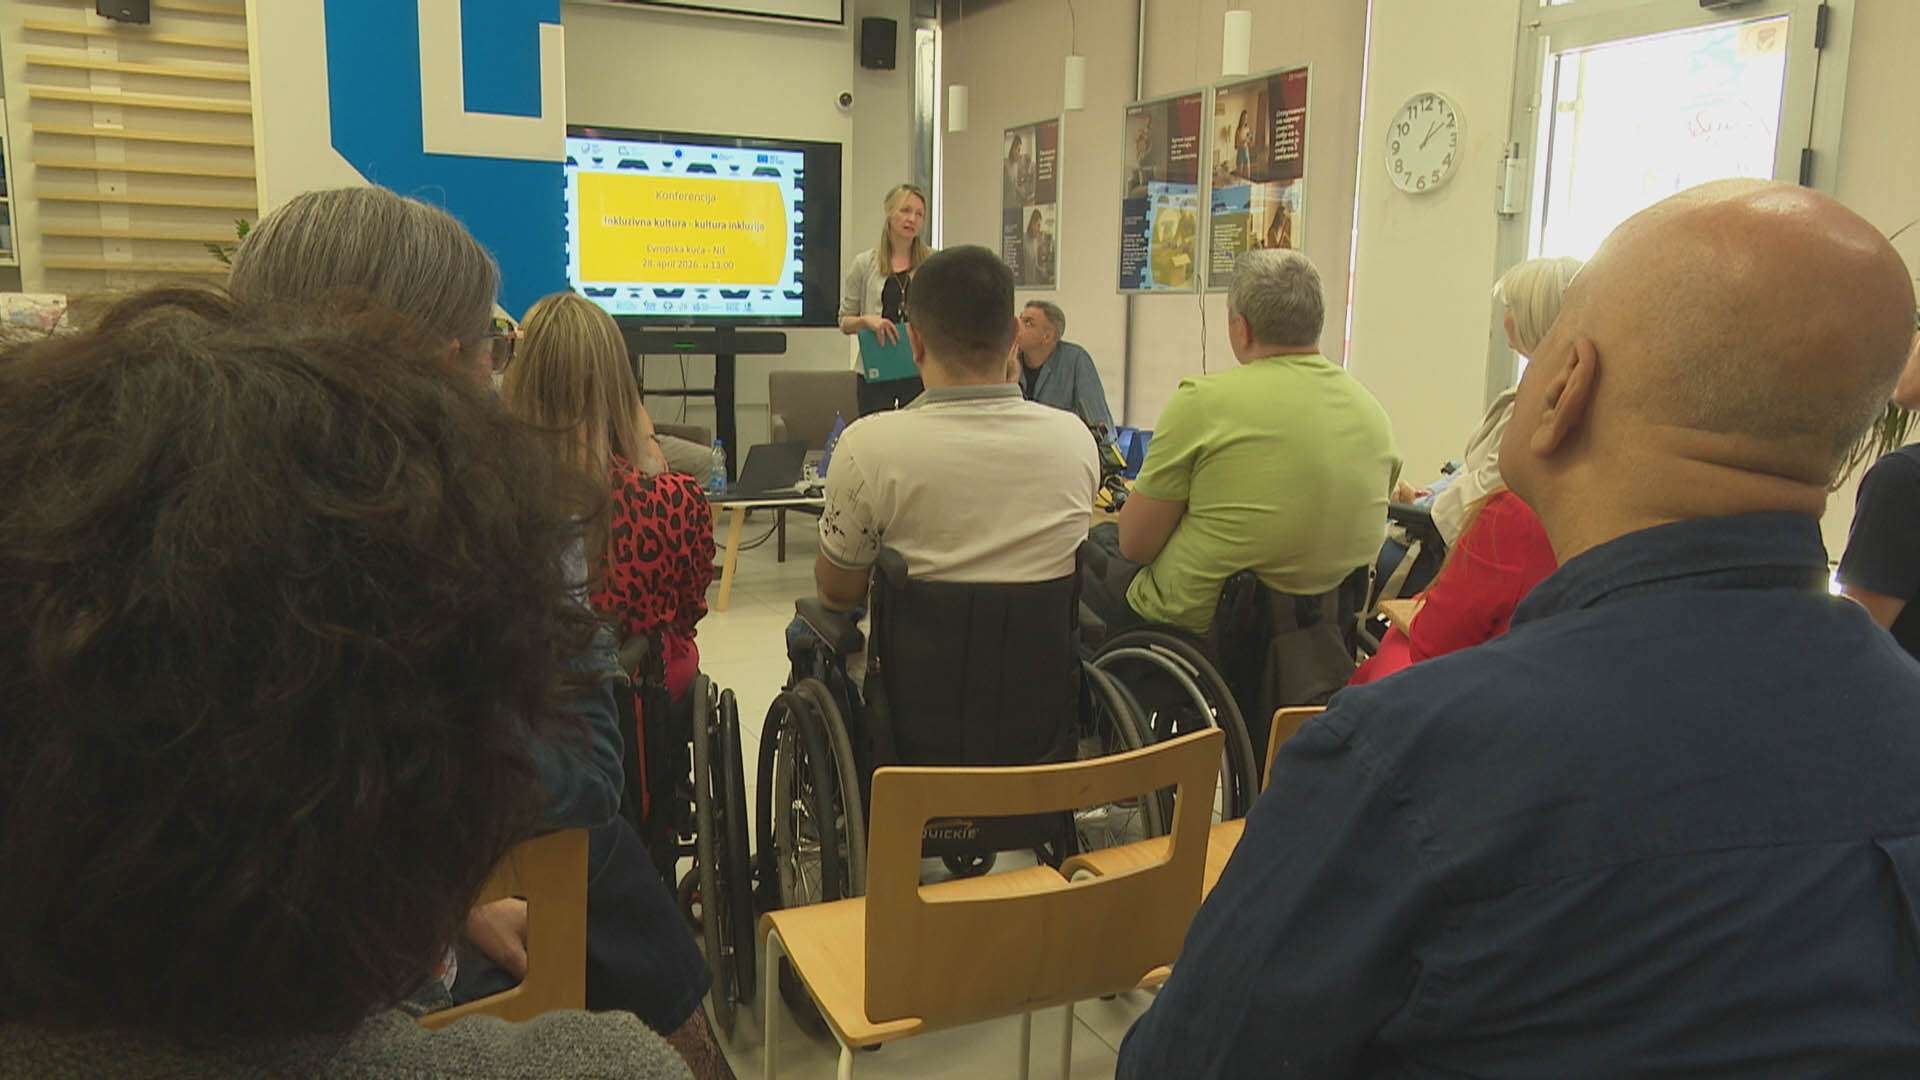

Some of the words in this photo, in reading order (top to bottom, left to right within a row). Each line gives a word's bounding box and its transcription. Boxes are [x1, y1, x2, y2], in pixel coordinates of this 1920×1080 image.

[1419, 96, 1434, 112] 12
[1438, 99, 1446, 114] 1
[1407, 105, 1418, 120] 11
[1446, 112, 1455, 128] 2
[1397, 121, 1410, 137] 10
[1449, 132, 1457, 147] 3
[1391, 140, 1400, 155] 9
[1394, 158, 1403, 174] 8
[1442, 152, 1452, 169] 4
[1404, 171, 1412, 185] 7
[1416, 175, 1425, 190] 6
[1431, 170, 1440, 184] 5
[655, 190, 717, 205] Konferencija
[603, 215, 652, 227] Inkluzivna
[654, 218, 687, 228] kultura
[694, 219, 727, 230] kultura
[646, 243, 685, 255] Evropska
[656, 259, 675, 270] april
